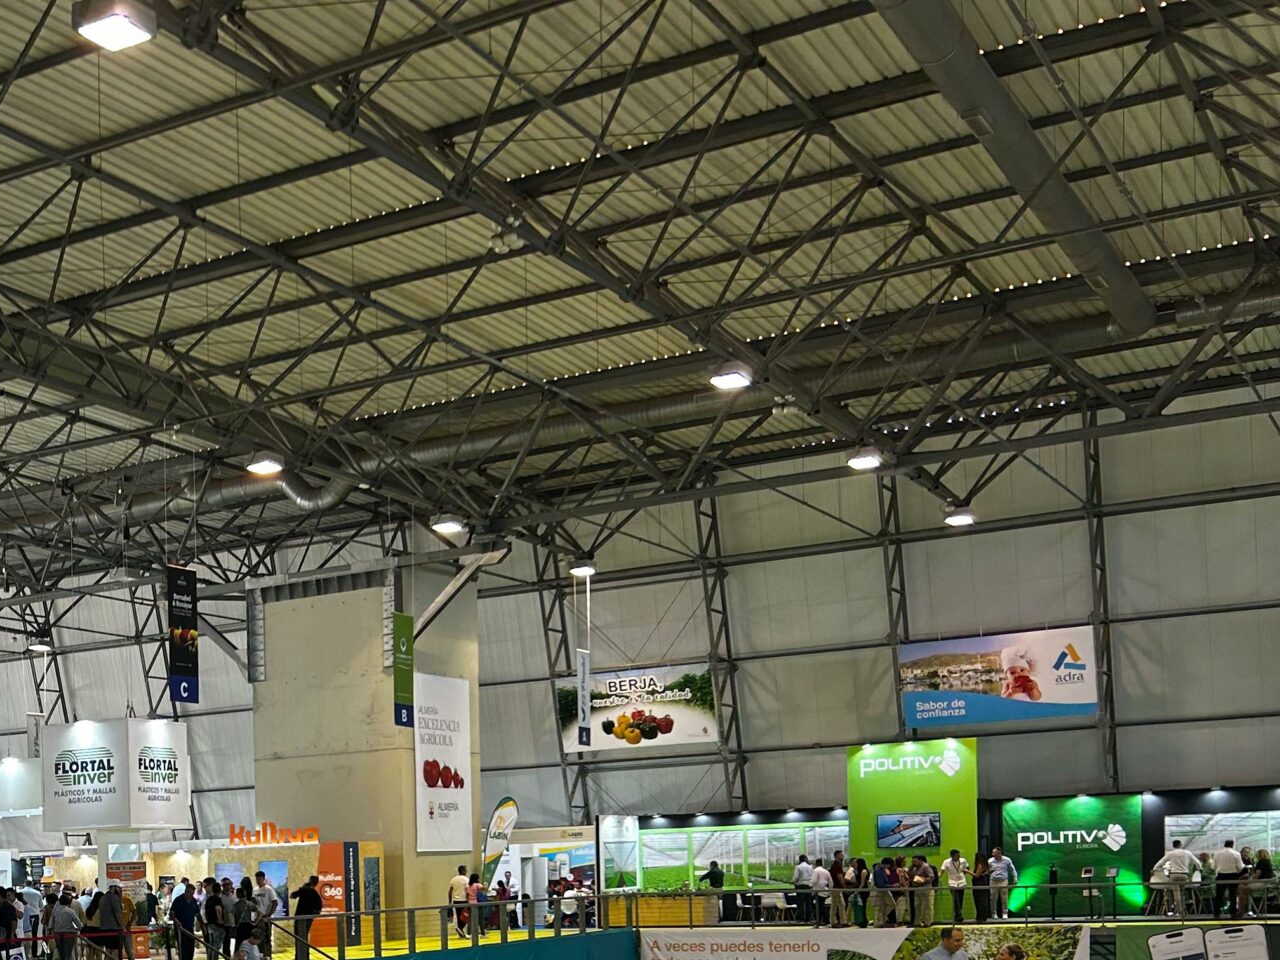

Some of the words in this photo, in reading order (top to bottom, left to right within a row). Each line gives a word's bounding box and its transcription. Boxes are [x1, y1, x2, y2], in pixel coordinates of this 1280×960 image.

[608, 677, 664, 693] BERJA,
[1055, 672, 1084, 683] adra
[180, 681, 189, 697] C
[916, 700, 948, 711] Sabor
[951, 698, 966, 709] de
[401, 708, 408, 722] B
[916, 708, 966, 720] confianza
[418, 717, 460, 732] EXCELENCIA
[55, 758, 115, 775] FLORTAL
[138, 757, 179, 772] FLORTAL
[72, 770, 115, 786] inver
[150, 769, 179, 784] inver
[54, 787, 86, 798] PLÁSTICOS
[86, 787, 91, 795] Y
[92, 786, 117, 795] MALLAS
[324, 887, 343, 897] 360
[650, 940, 662, 952] A
[664, 941, 706, 953] veces
[710, 940, 764, 955] puedes
[768, 940, 820, 953] tenerlo
